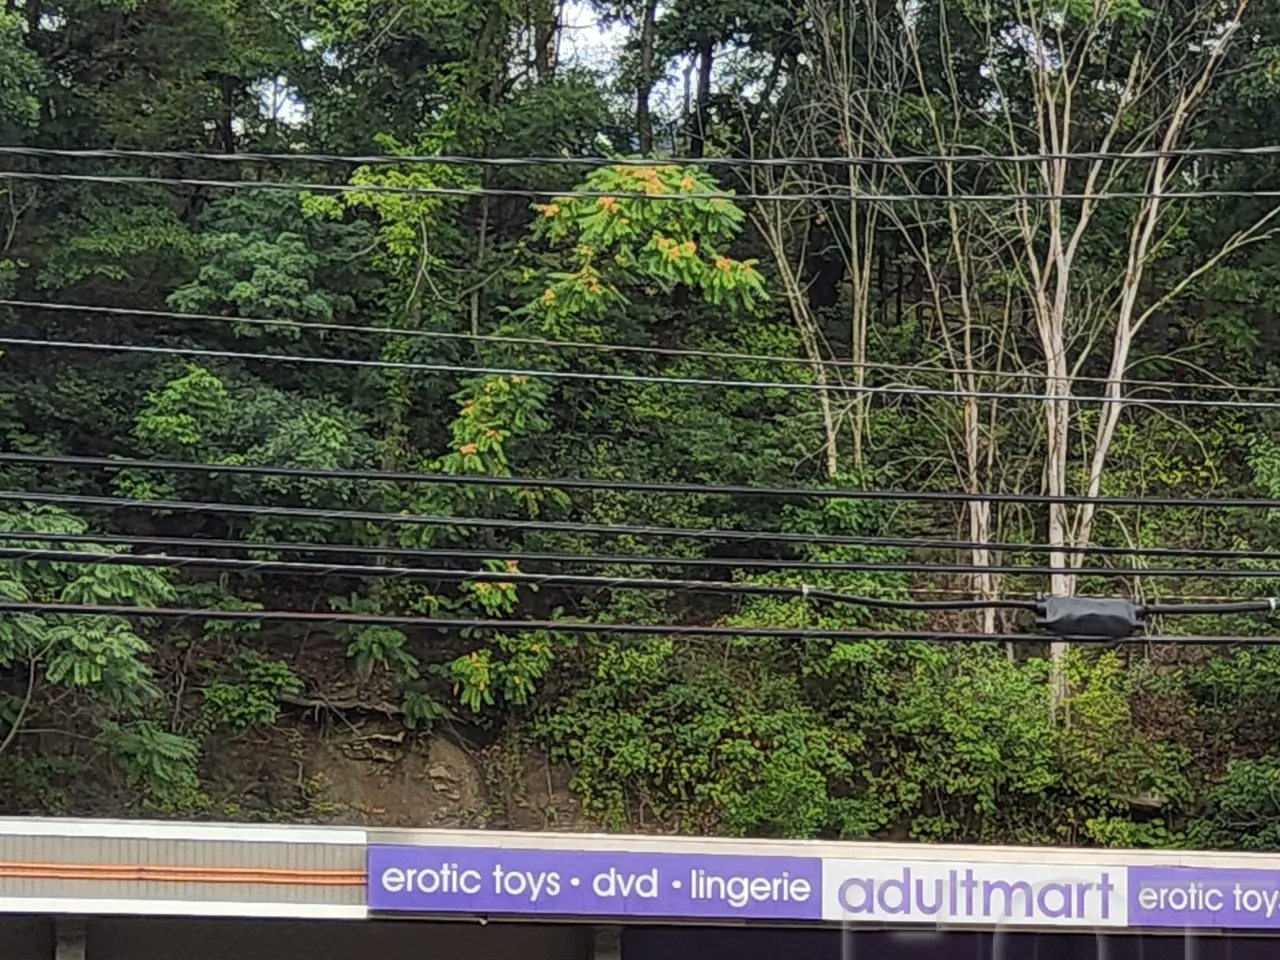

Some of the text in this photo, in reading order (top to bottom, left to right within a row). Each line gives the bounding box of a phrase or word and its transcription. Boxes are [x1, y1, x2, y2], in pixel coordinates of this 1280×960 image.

[382, 862, 811, 908] erotic toys dvd lingerie
[838, 867, 1114, 919] adultmart
[1139, 881, 1223, 912] erotic
